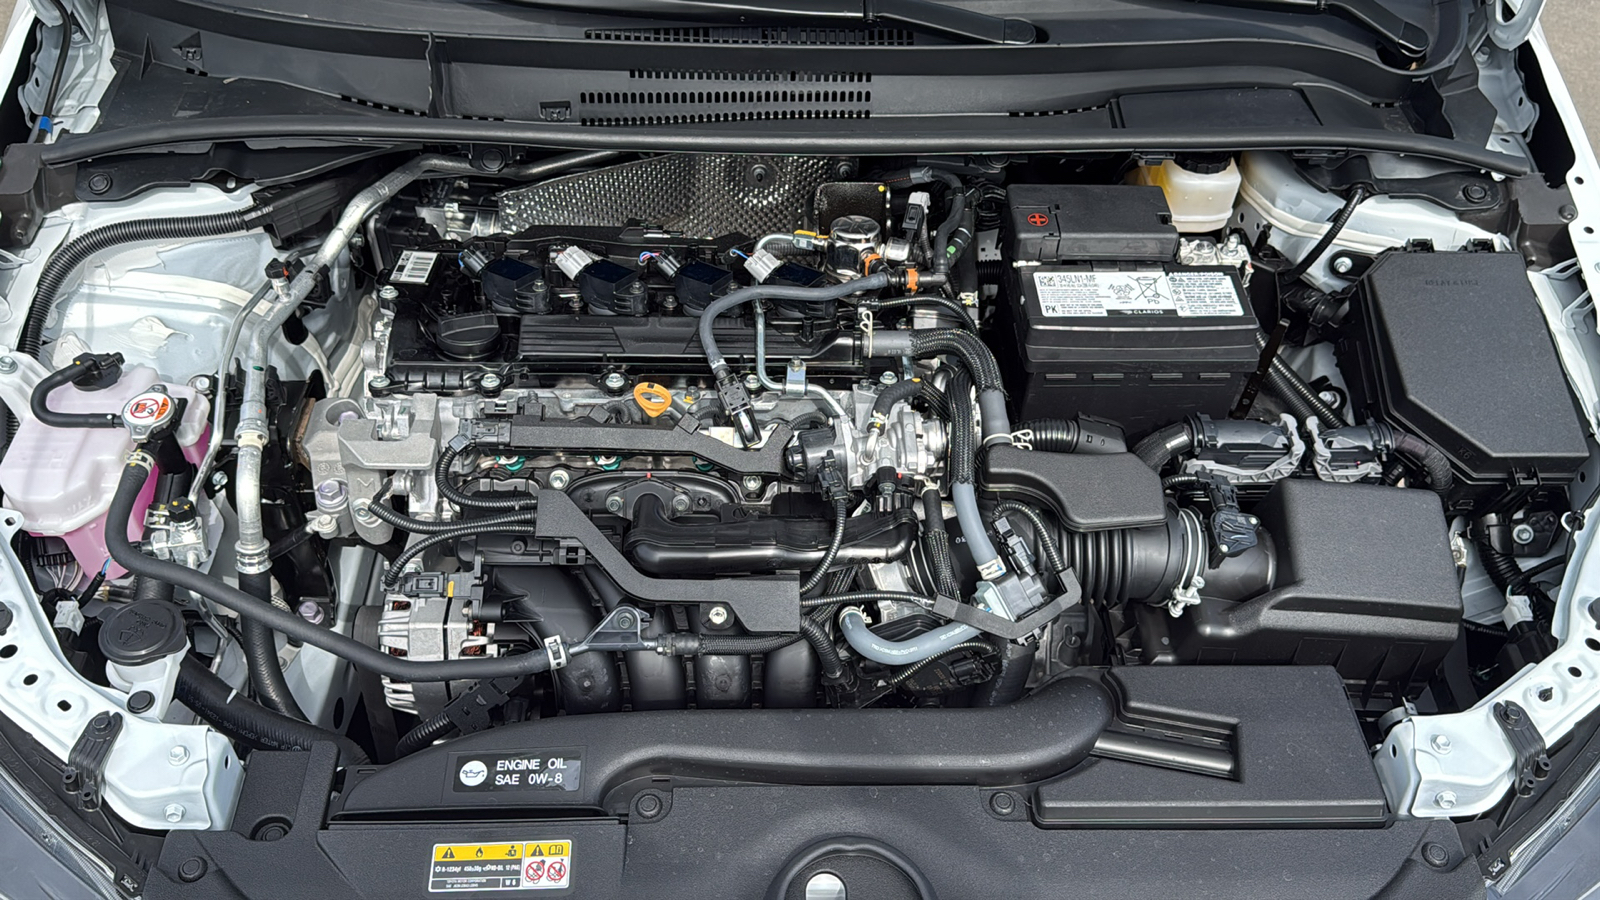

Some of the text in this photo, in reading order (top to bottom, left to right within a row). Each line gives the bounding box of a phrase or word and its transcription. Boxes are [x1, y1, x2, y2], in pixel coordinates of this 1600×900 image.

[1045, 305, 1058, 314] PK
[497, 757, 567, 770] ENGINE OIL
[494, 772, 563, 785] SAE 0W-8
